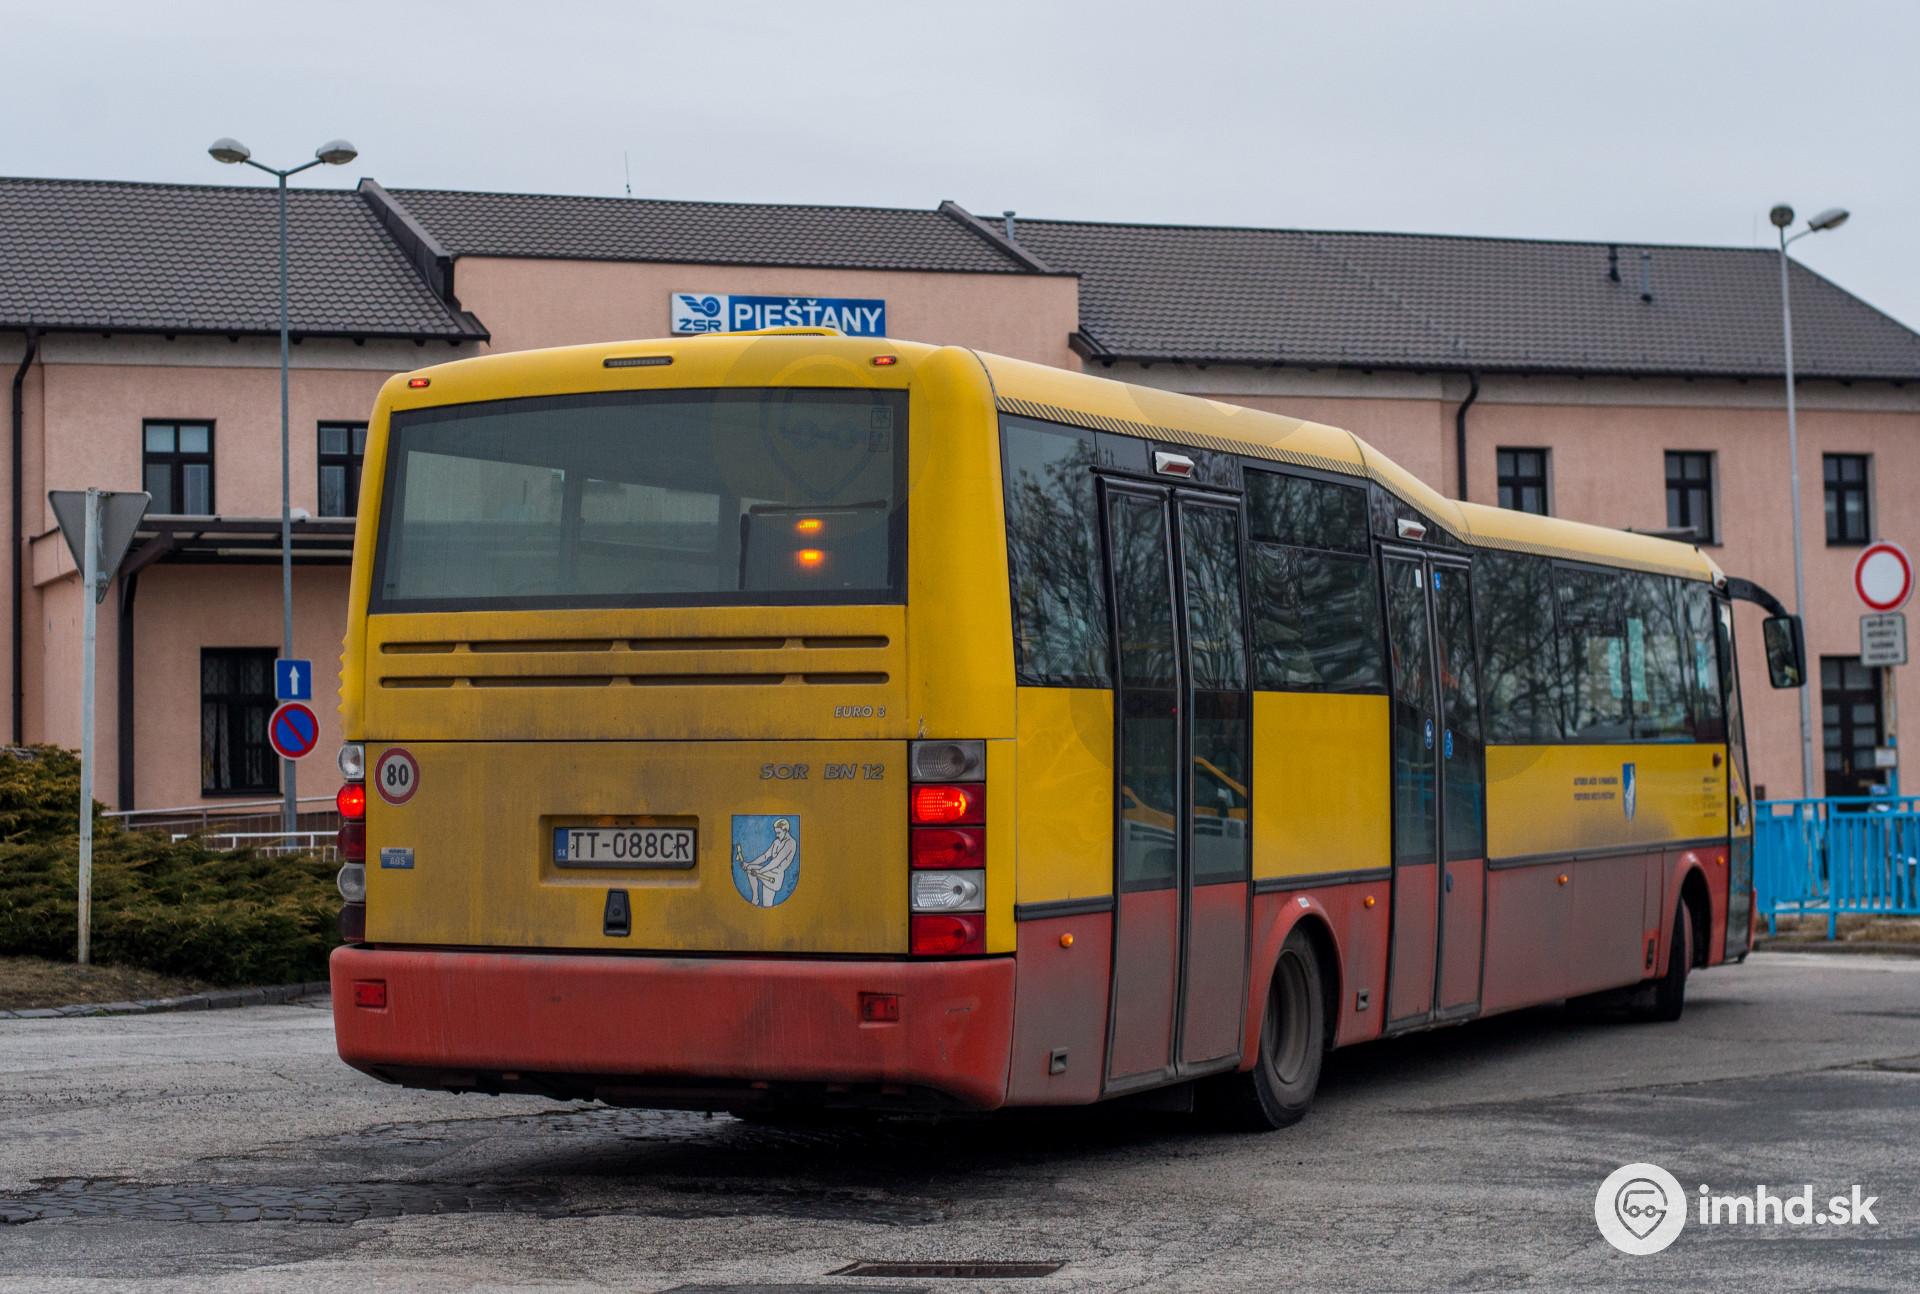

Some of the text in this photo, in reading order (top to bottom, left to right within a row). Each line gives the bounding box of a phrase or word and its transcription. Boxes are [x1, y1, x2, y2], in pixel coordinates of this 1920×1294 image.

[734, 300, 882, 333] PIEŠŤANY
[834, 705, 887, 718] EURO 3
[387, 763, 409, 786] 80
[760, 763, 885, 780] SOR BN 12
[571, 832, 690, 859] TT-088CR
